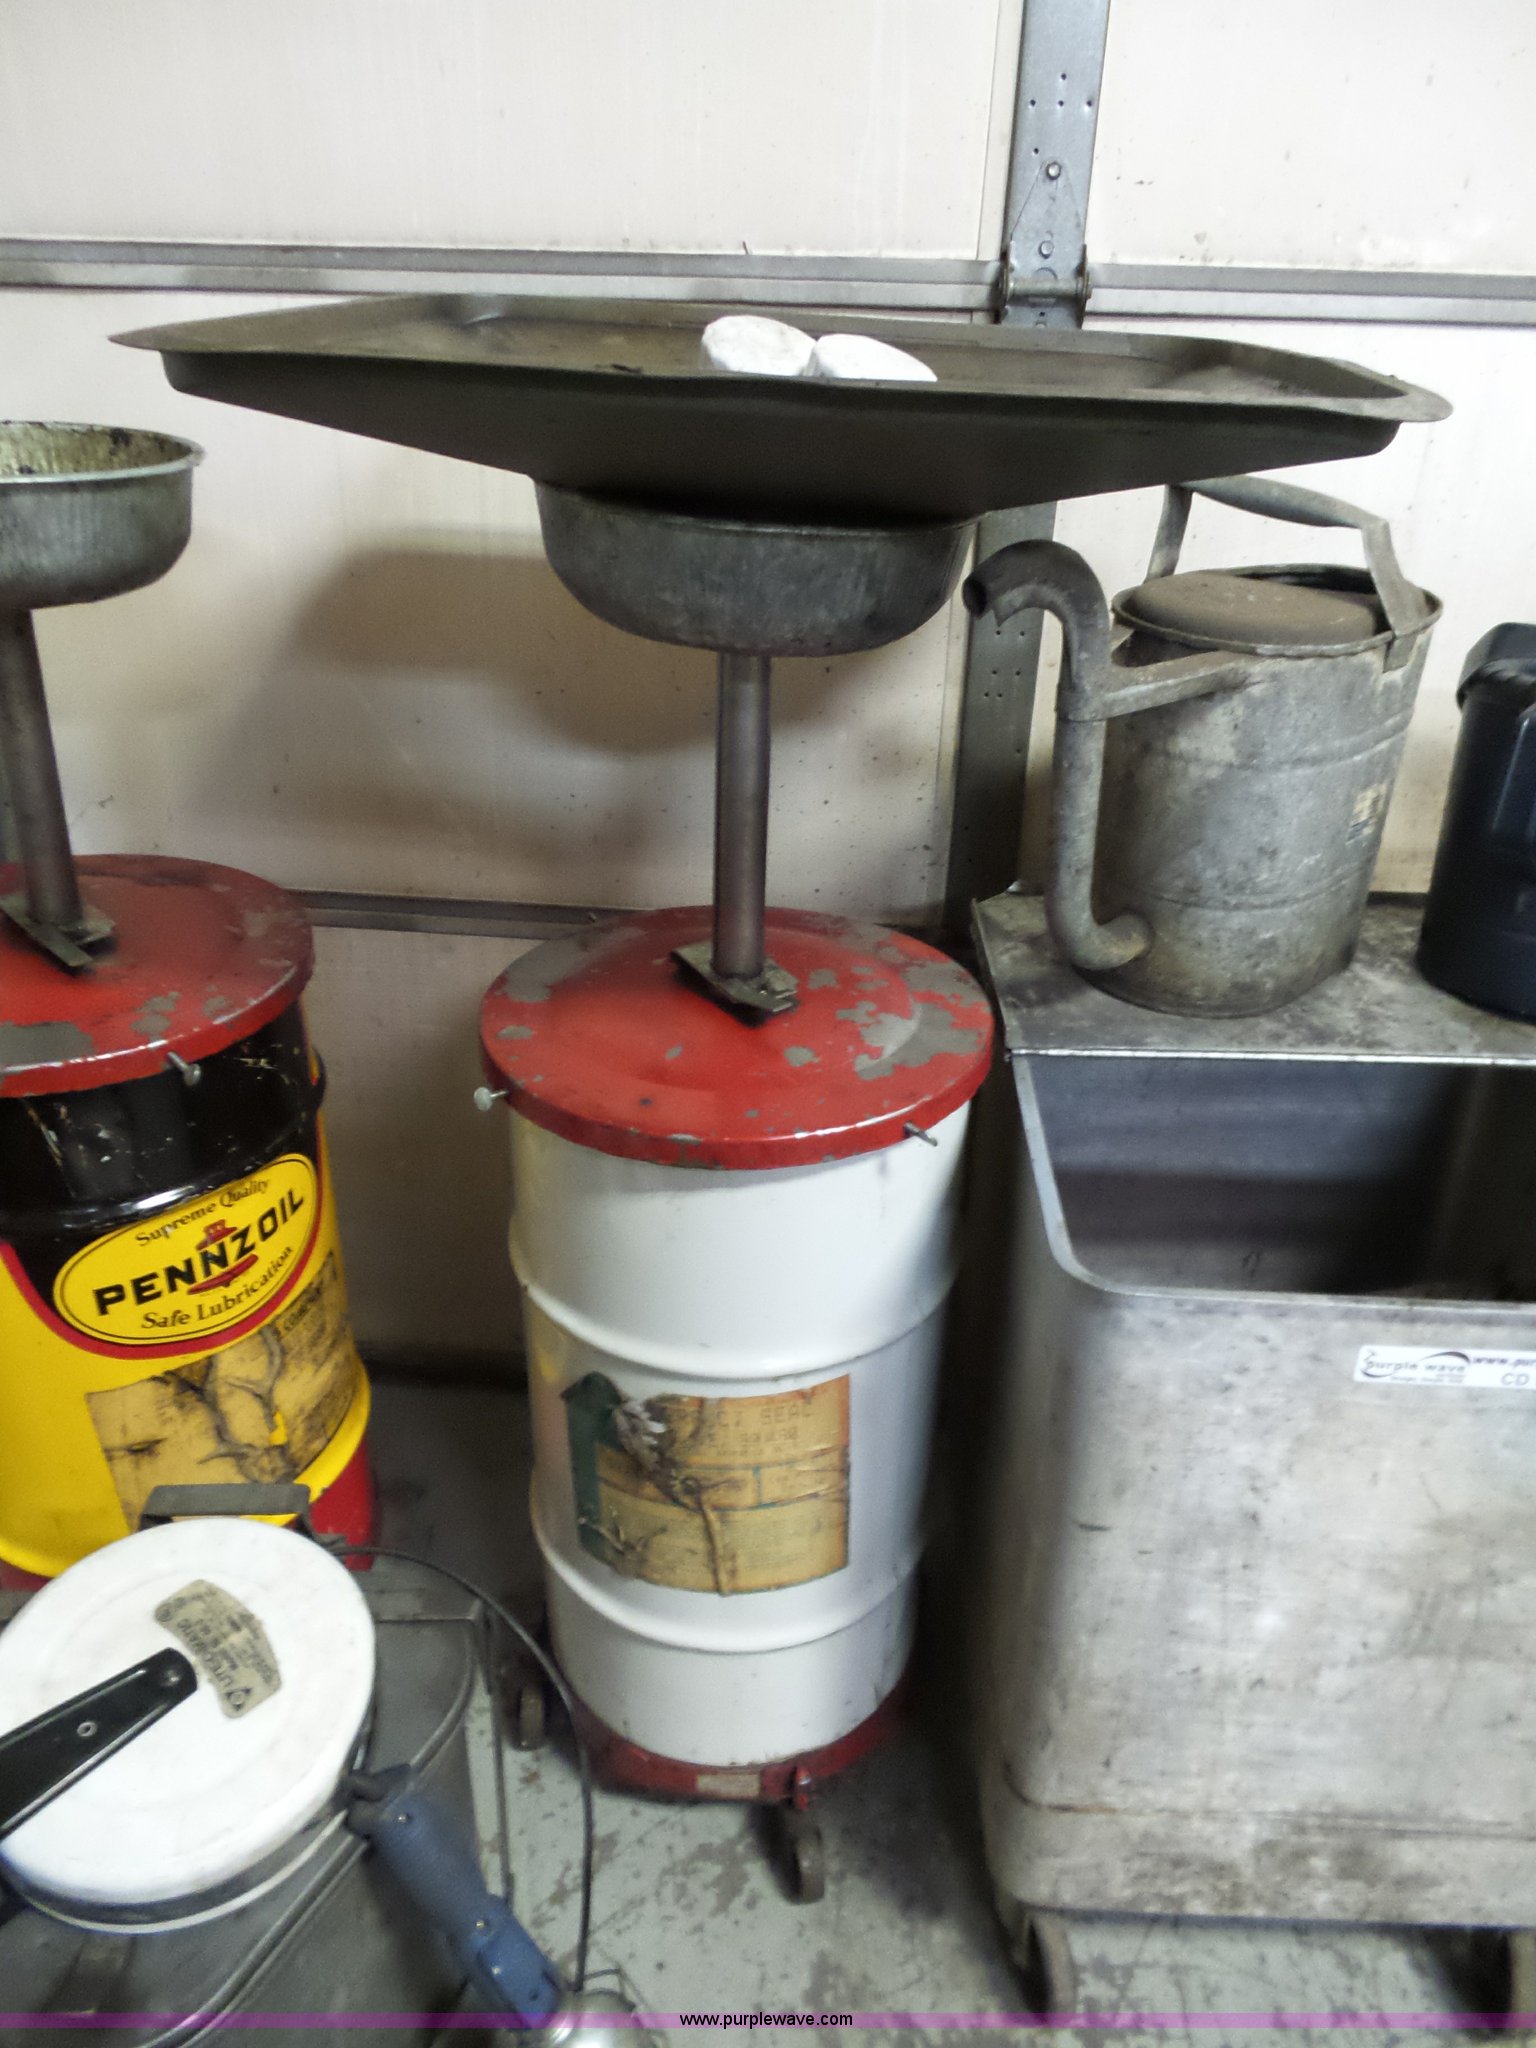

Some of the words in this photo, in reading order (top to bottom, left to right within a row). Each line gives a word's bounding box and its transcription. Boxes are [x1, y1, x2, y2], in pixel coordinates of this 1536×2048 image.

[136, 1202, 217, 1246] Supreme
[219, 1179, 269, 1208] Quality
[93, 1189, 304, 1315] PENNZOIL
[141, 1311, 191, 1329] Safe
[197, 1246, 293, 1321] Lubrication
[1425, 1363, 1466, 1372] wave
